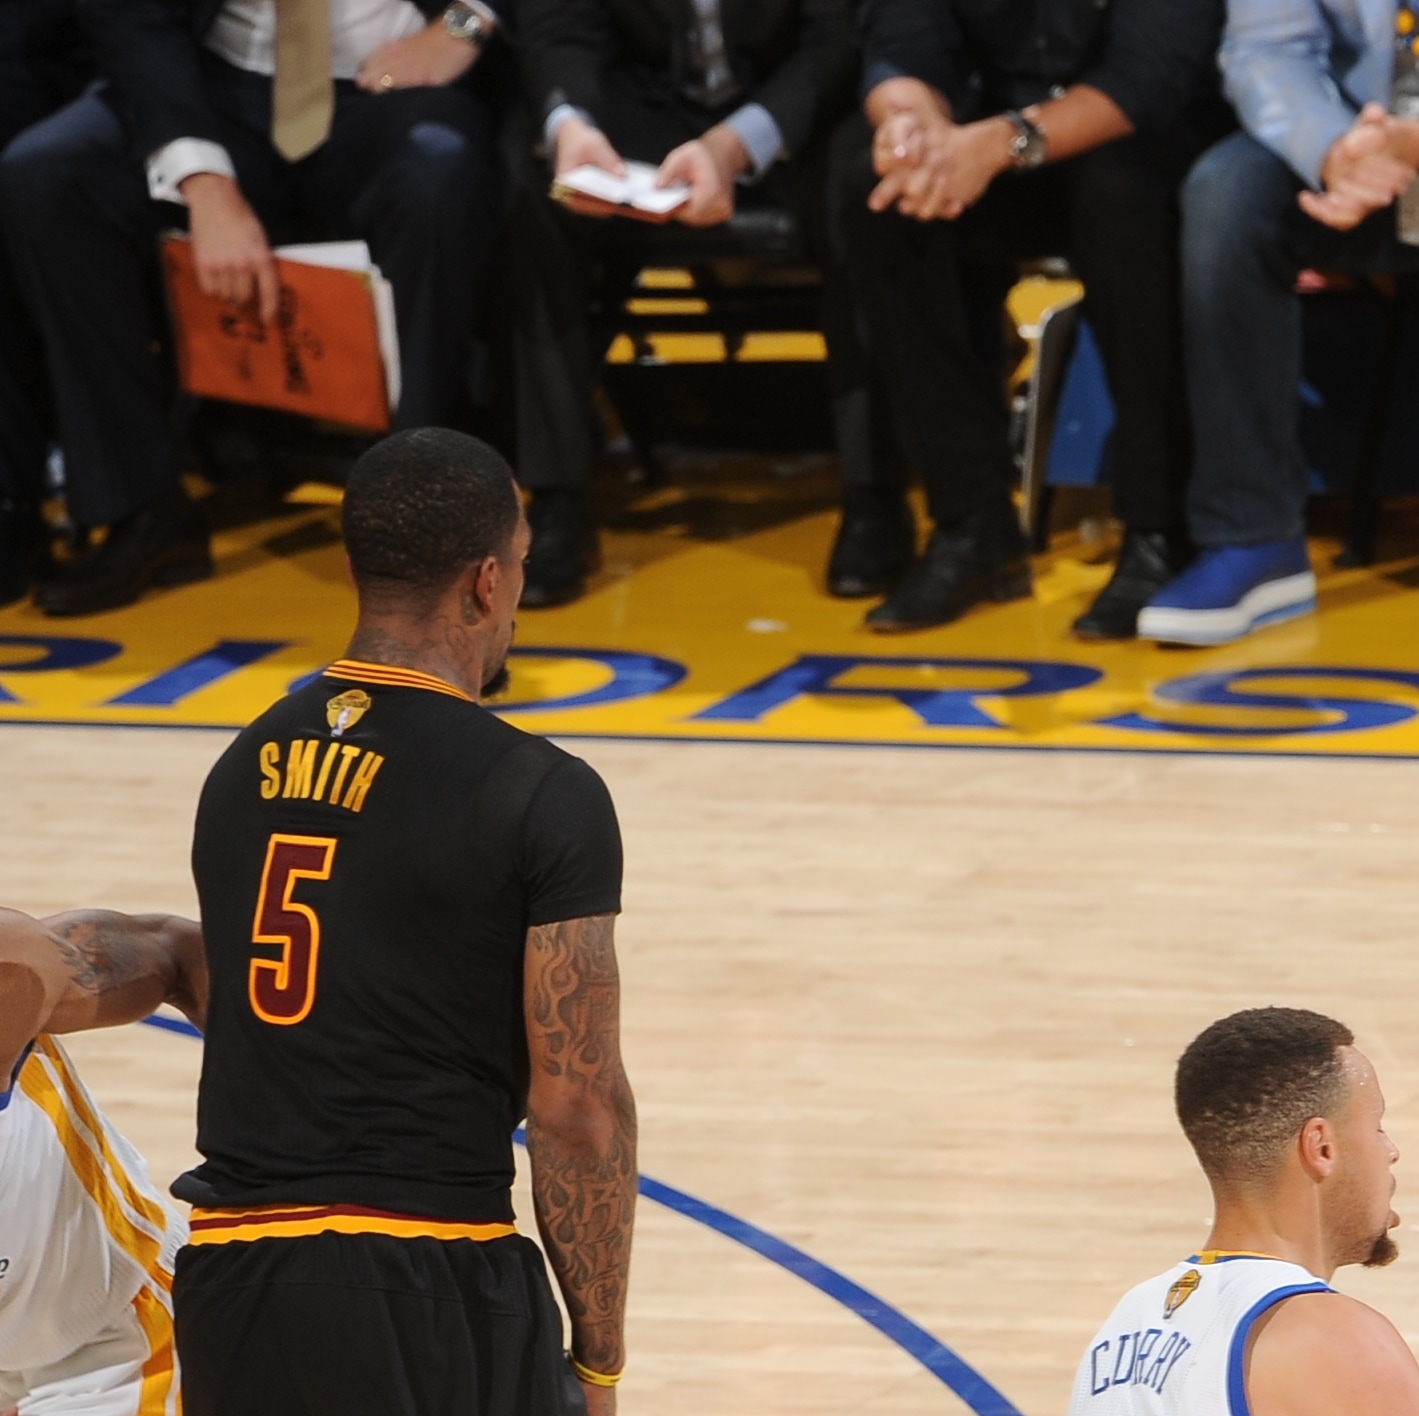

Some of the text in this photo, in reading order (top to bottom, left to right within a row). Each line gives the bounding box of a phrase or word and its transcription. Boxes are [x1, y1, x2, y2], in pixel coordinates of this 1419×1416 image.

[259, 739, 384, 813] SMITH
[248, 833, 338, 1026] 5
[1091, 1328, 1191, 1396] CURRY
